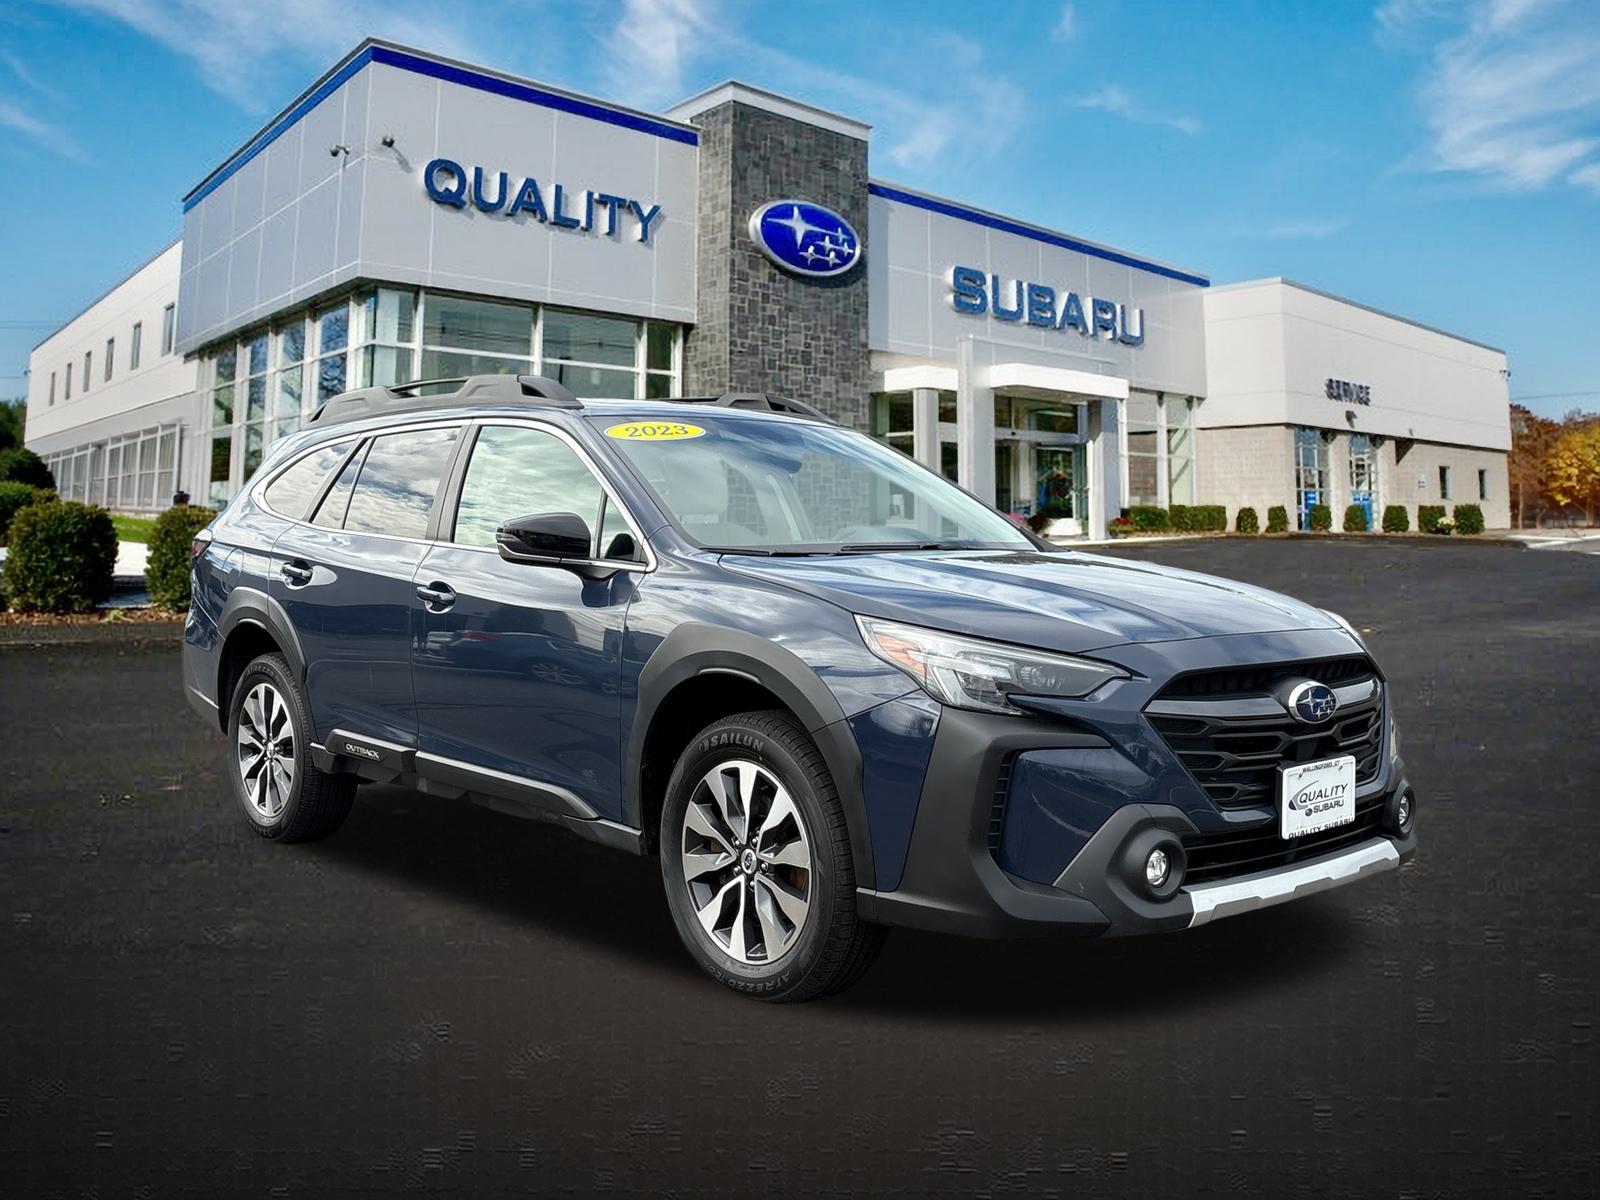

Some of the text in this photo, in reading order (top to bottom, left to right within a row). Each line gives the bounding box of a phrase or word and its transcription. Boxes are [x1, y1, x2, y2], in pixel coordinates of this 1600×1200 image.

[424, 158, 661, 243] QUALITY
[950, 265, 1144, 347] SUBARU
[1325, 378, 1370, 406] SERVICE
[625, 425, 688, 438] 2023
[345, 743, 379, 759] OUTBACK
[710, 732, 764, 752] SAILUN
[1300, 783, 1348, 804] QUALITY
[1313, 799, 1344, 813] SUBARU
[1288, 825, 1321, 839] QUALITY
